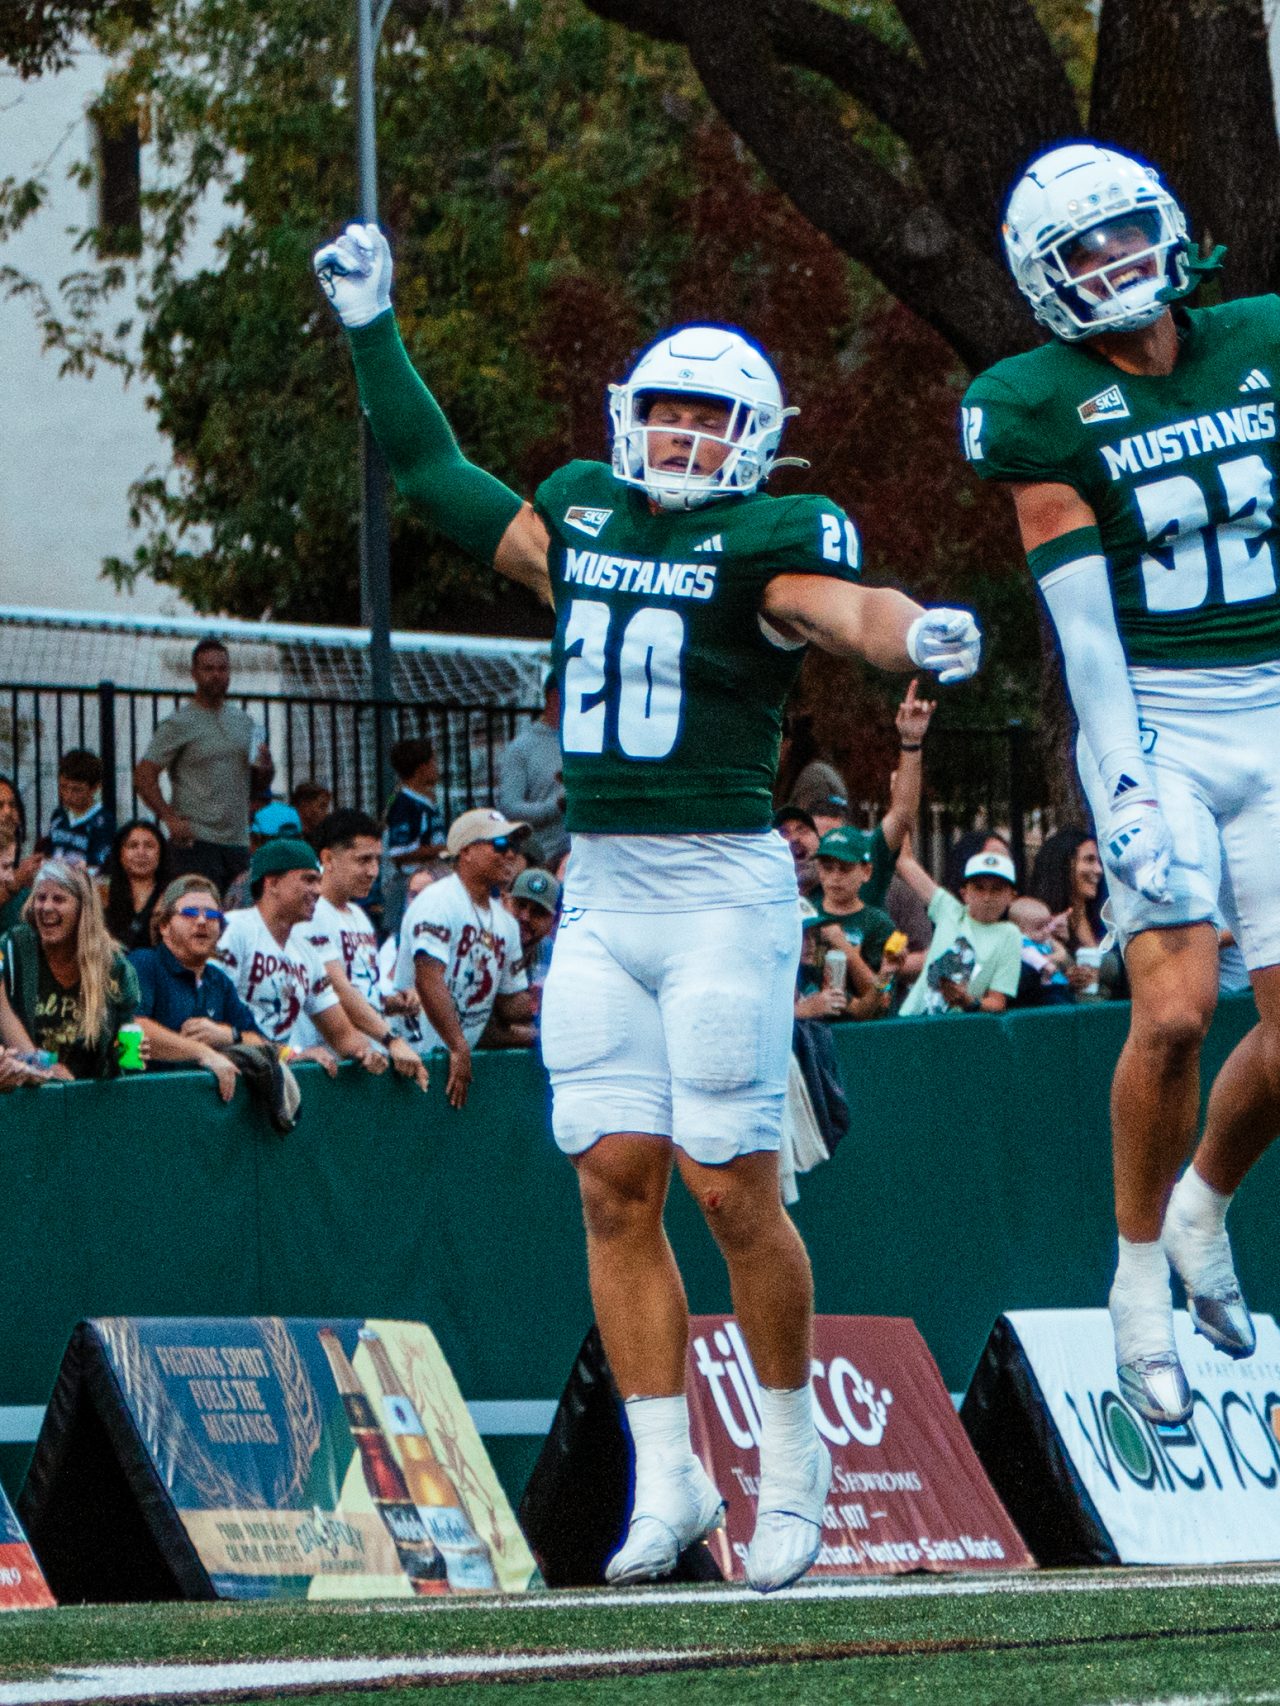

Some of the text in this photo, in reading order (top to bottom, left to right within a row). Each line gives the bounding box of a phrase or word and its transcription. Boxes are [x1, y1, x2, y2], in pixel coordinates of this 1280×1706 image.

[1100, 402, 1277, 481] MUSTANGS
[1134, 454, 1278, 614] 32
[563, 547, 717, 600] MUSTANGS
[562, 599, 685, 758] 20
[220, 1346, 270, 1378] SPIRIT
[188, 1379, 267, 1411] FUELS THE
[200, 1413, 280, 1444] MUSTANGS
[960, 1535, 1006, 1560] Maria
